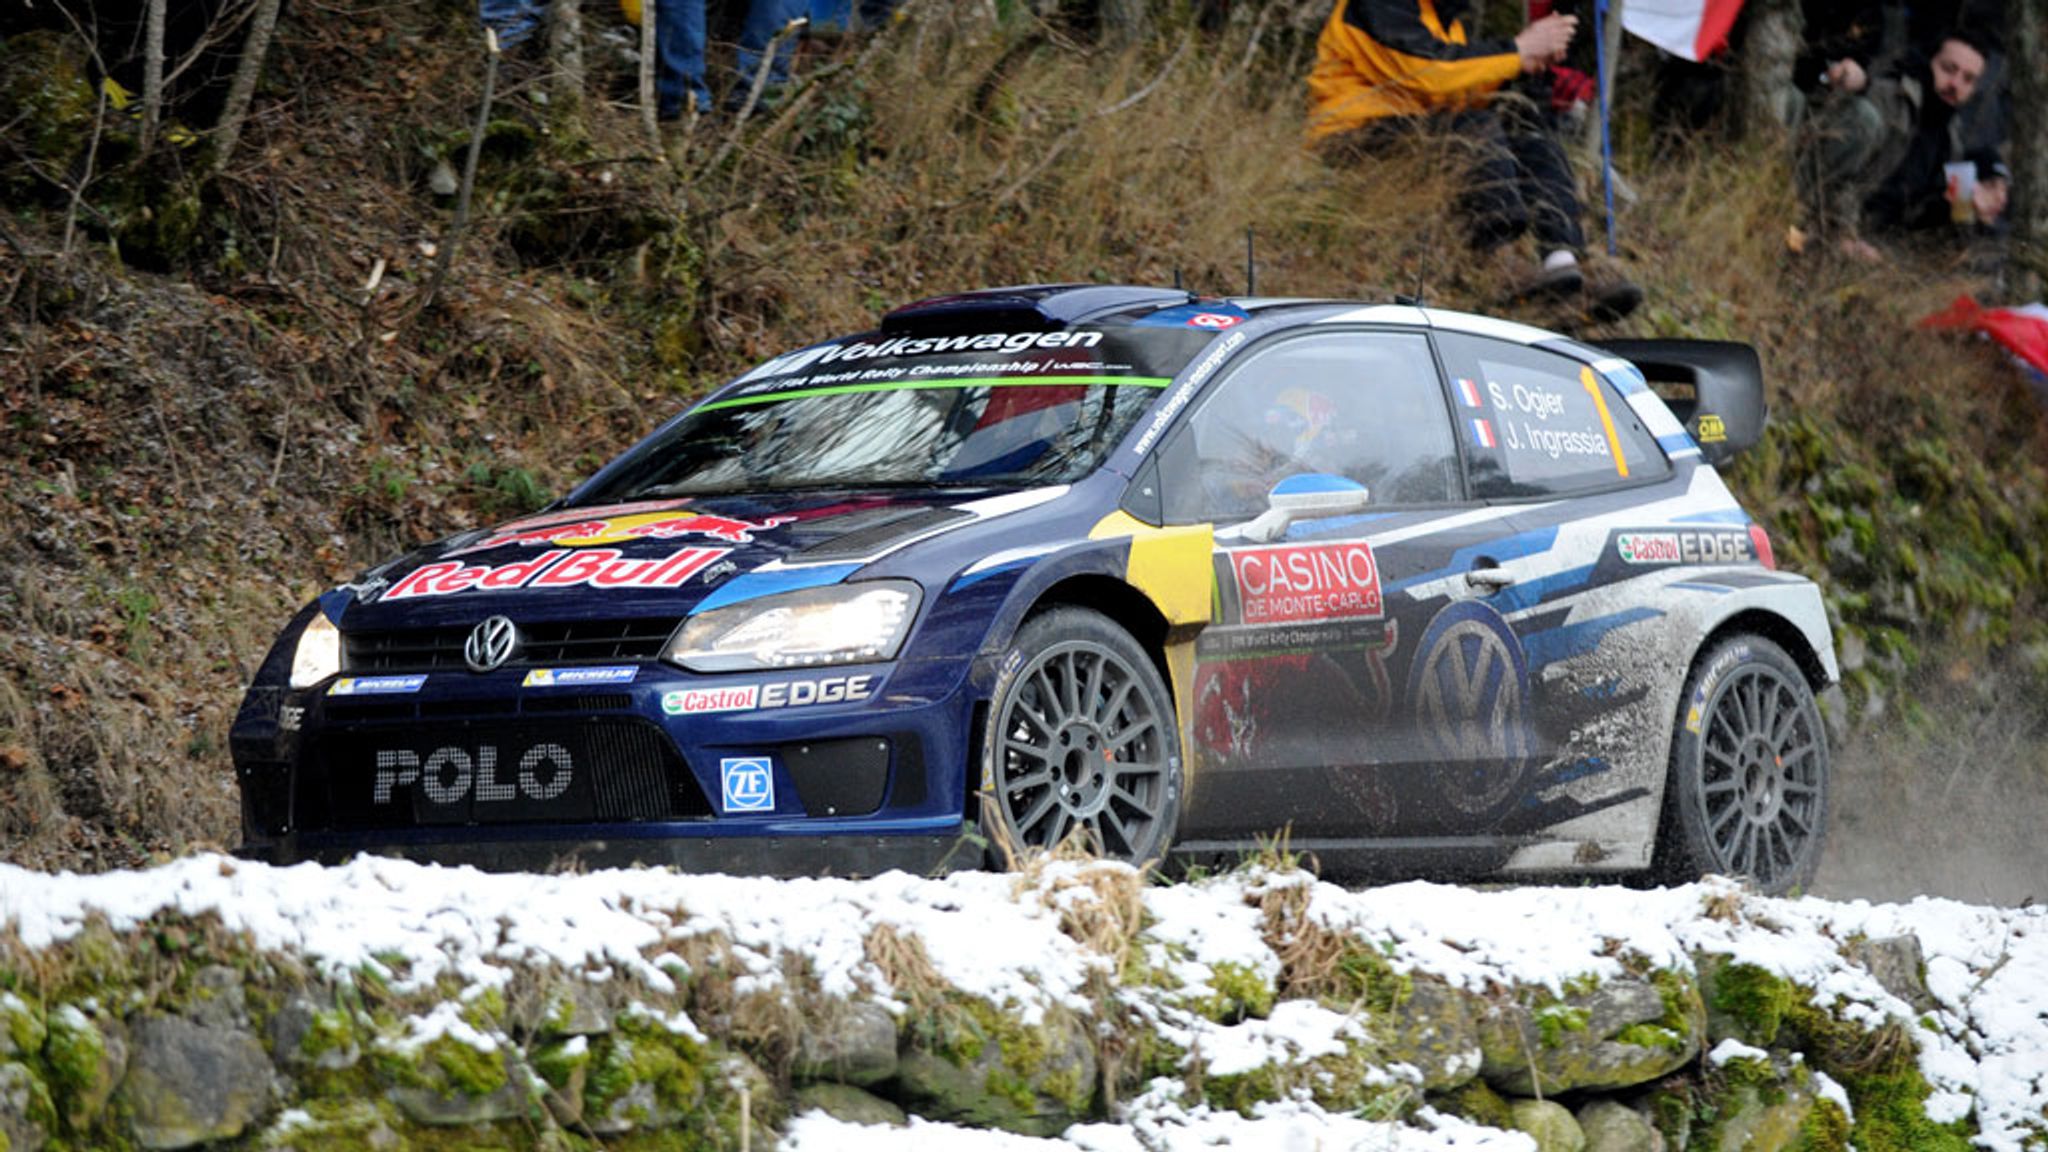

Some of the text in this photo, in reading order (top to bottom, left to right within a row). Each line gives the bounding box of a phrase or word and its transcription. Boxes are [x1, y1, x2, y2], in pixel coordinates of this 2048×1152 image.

[819, 331, 1104, 364] Volkswagen
[859, 367, 907, 380] Rally
[908, 360, 1040, 376] Championship
[1487, 381, 1565, 420] S. Ogier
[1580, 365, 1629, 478] 1
[1506, 422, 1609, 459] J. Ingrassia
[1632, 532, 1750, 562] Castrol EDGE
[377, 549, 569, 602] Red
[526, 546, 736, 589] Bull
[1238, 545, 1374, 596] CASINO
[1245, 590, 1378, 618] DE MONTE-CARLO
[557, 669, 634, 681] MICHELIN
[683, 674, 872, 713] Castrol EDGE
[374, 744, 573, 804] POLO
[732, 770, 771, 799] ZF
